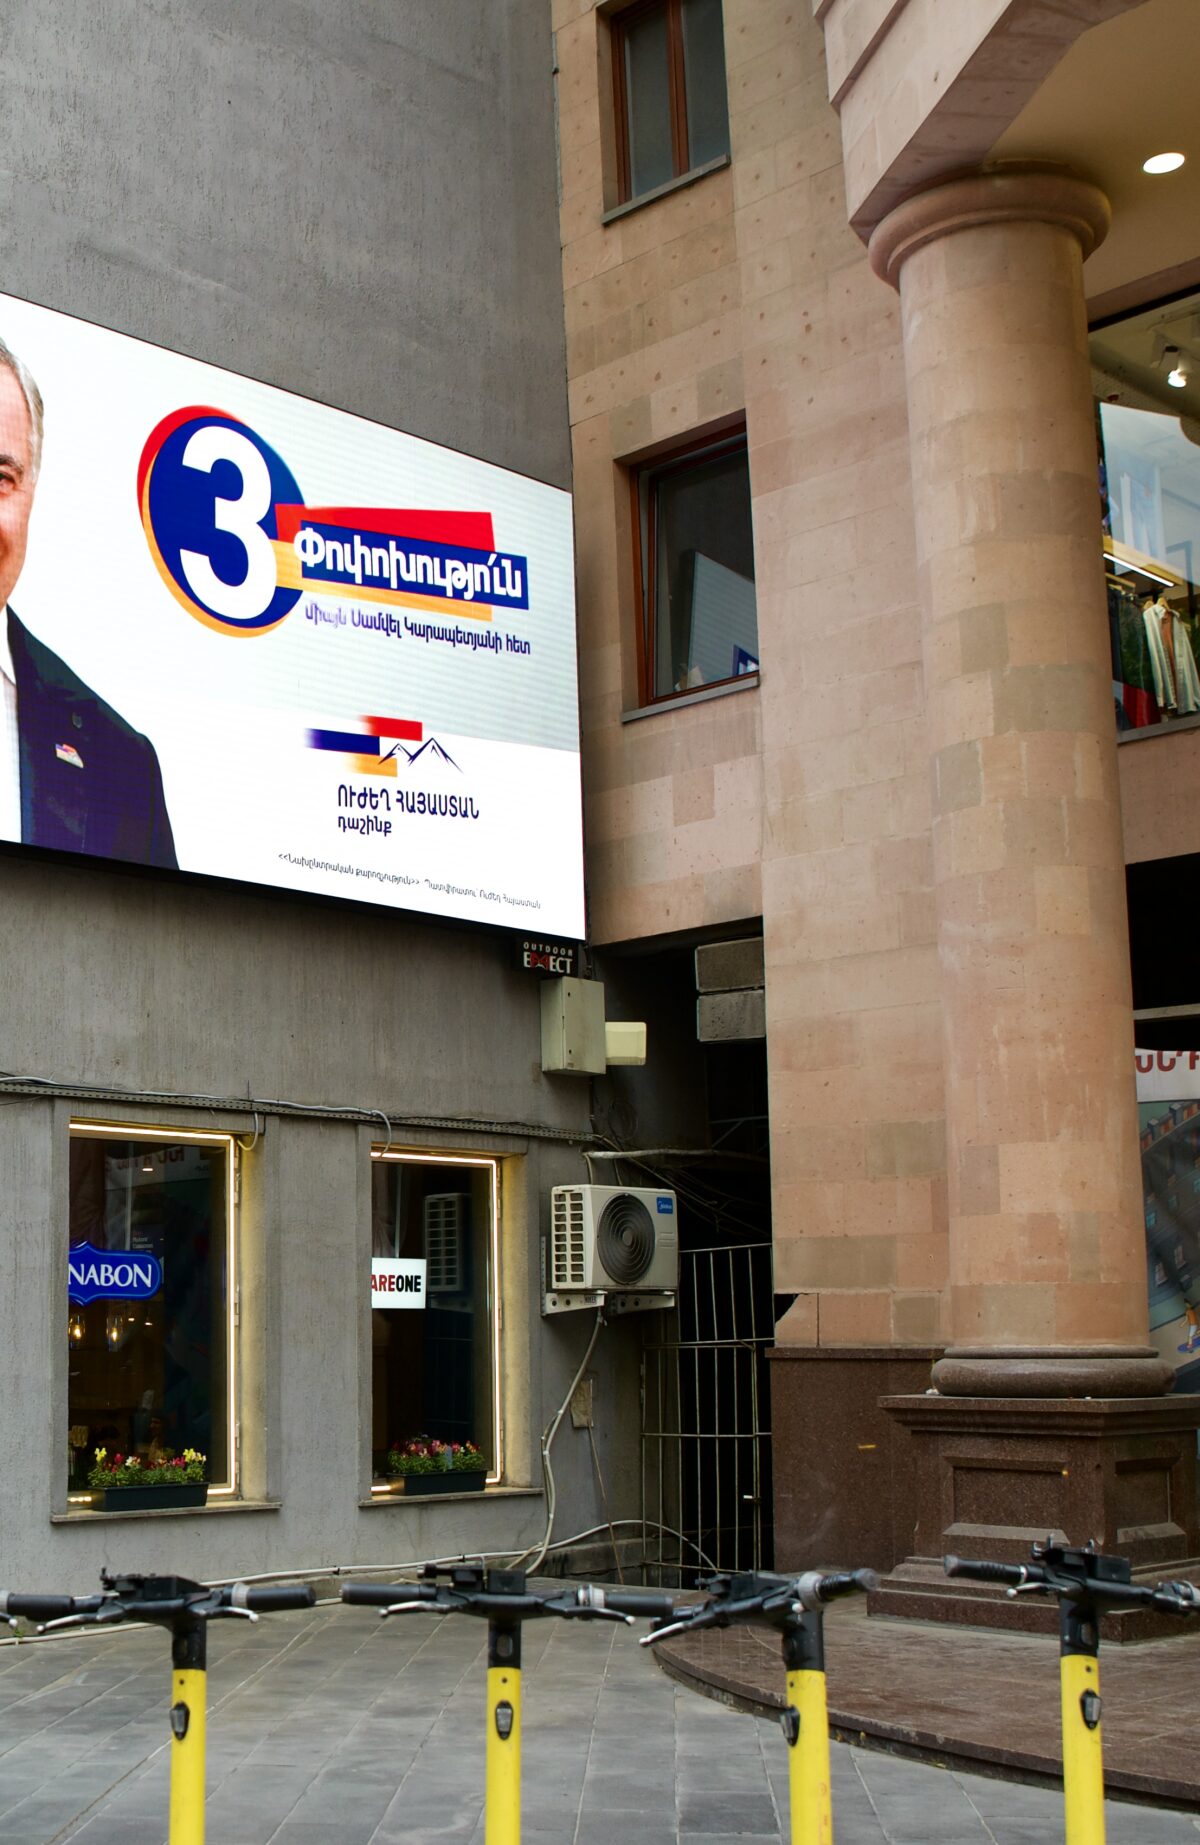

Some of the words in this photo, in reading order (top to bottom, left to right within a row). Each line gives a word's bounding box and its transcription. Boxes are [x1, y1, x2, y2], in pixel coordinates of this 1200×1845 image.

[179, 425, 277, 620] 3
[350, 608, 402, 639] Սամվել
[404, 616, 503, 654] Կարապետյանի
[505, 633, 531, 655] հետ
[337, 784, 391, 812] ՈՒԺԵՂ
[395, 790, 480, 820] ՀԱՅԱՍՏԱՆ
[337, 814, 392, 837] դաշինք
[523, 941, 573, 957] OUTDOOR
